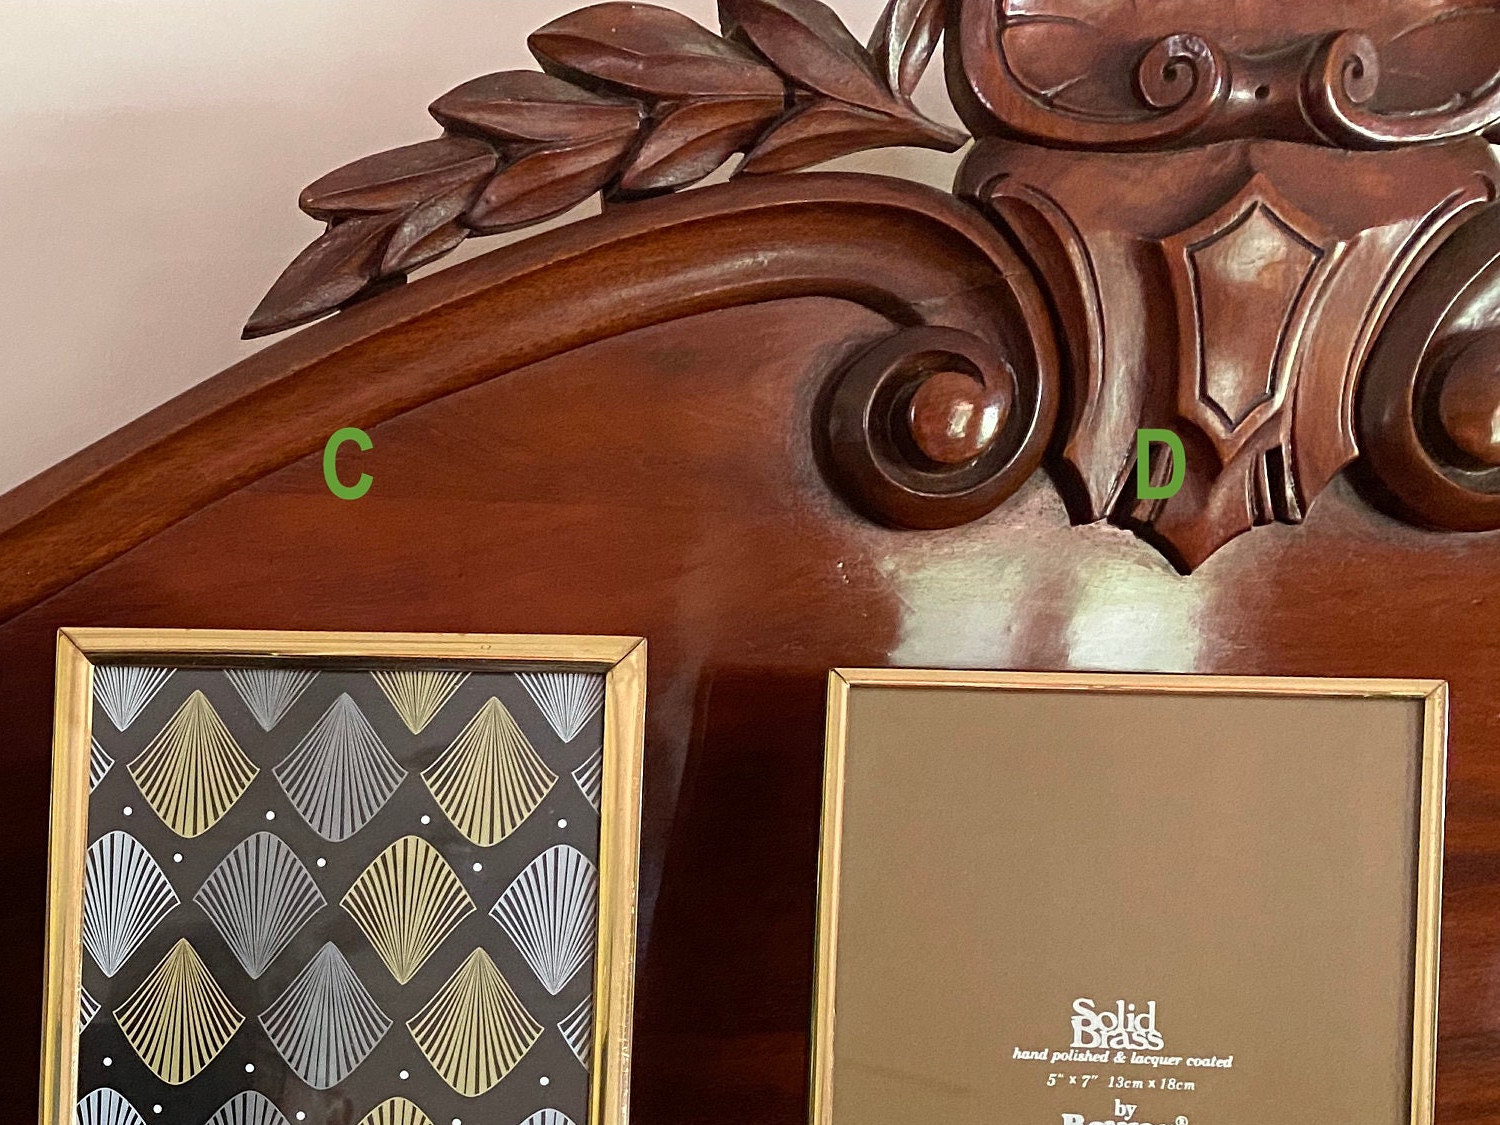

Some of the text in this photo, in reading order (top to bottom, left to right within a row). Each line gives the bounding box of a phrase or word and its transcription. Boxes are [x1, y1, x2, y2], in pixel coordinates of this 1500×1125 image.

[1071, 997, 1157, 1034] Solid
[1069, 1016, 1165, 1051] Brass
[1012, 1047, 1234, 1069] hand polished & lacquer coated
[1107, 1076, 1144, 1089] 13cm
[1159, 1077, 1196, 1091] 18cm
[1114, 1098, 1138, 1121] by
